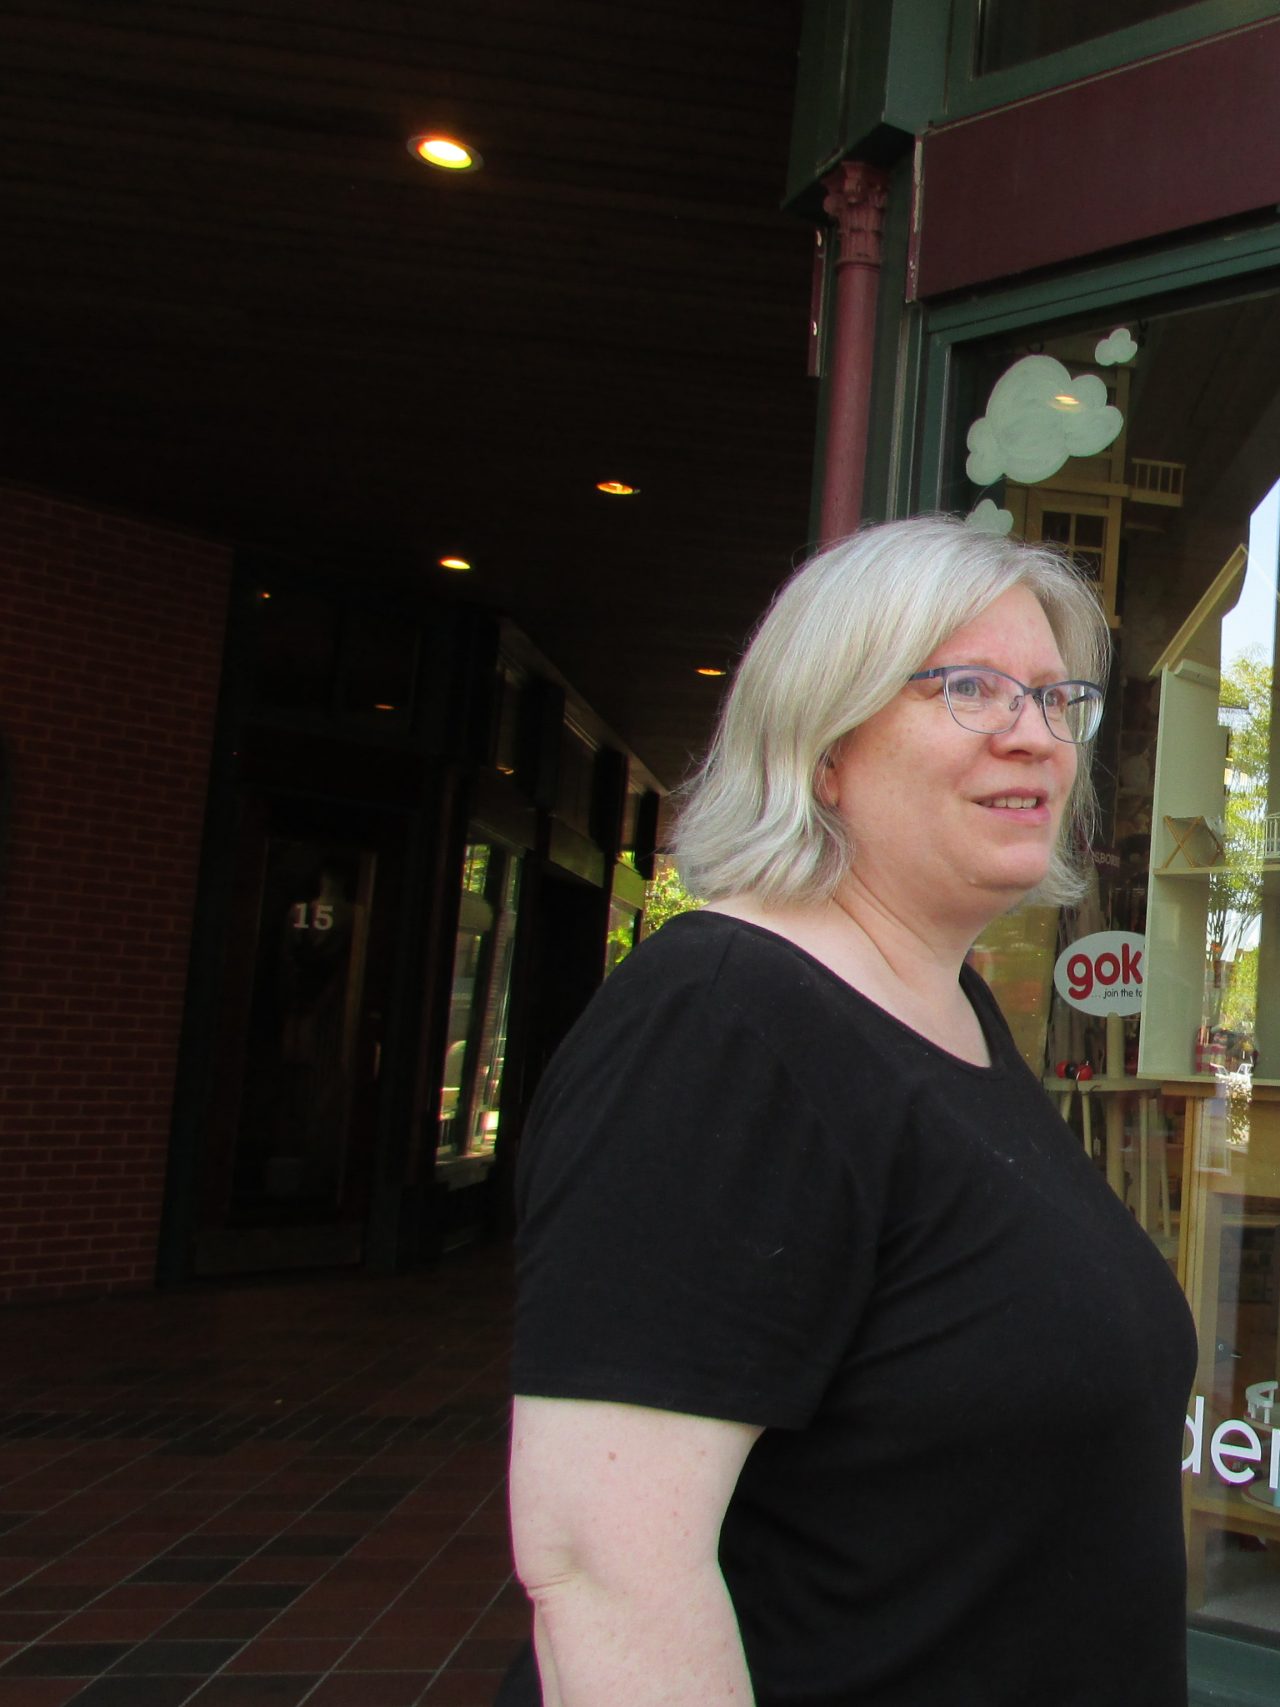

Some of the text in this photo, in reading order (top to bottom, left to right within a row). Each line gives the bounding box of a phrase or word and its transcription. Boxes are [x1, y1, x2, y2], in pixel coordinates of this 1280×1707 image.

[293, 903, 334, 931] 15
[1067, 943, 1145, 1001] gok
[1121, 988, 1134, 998] the
